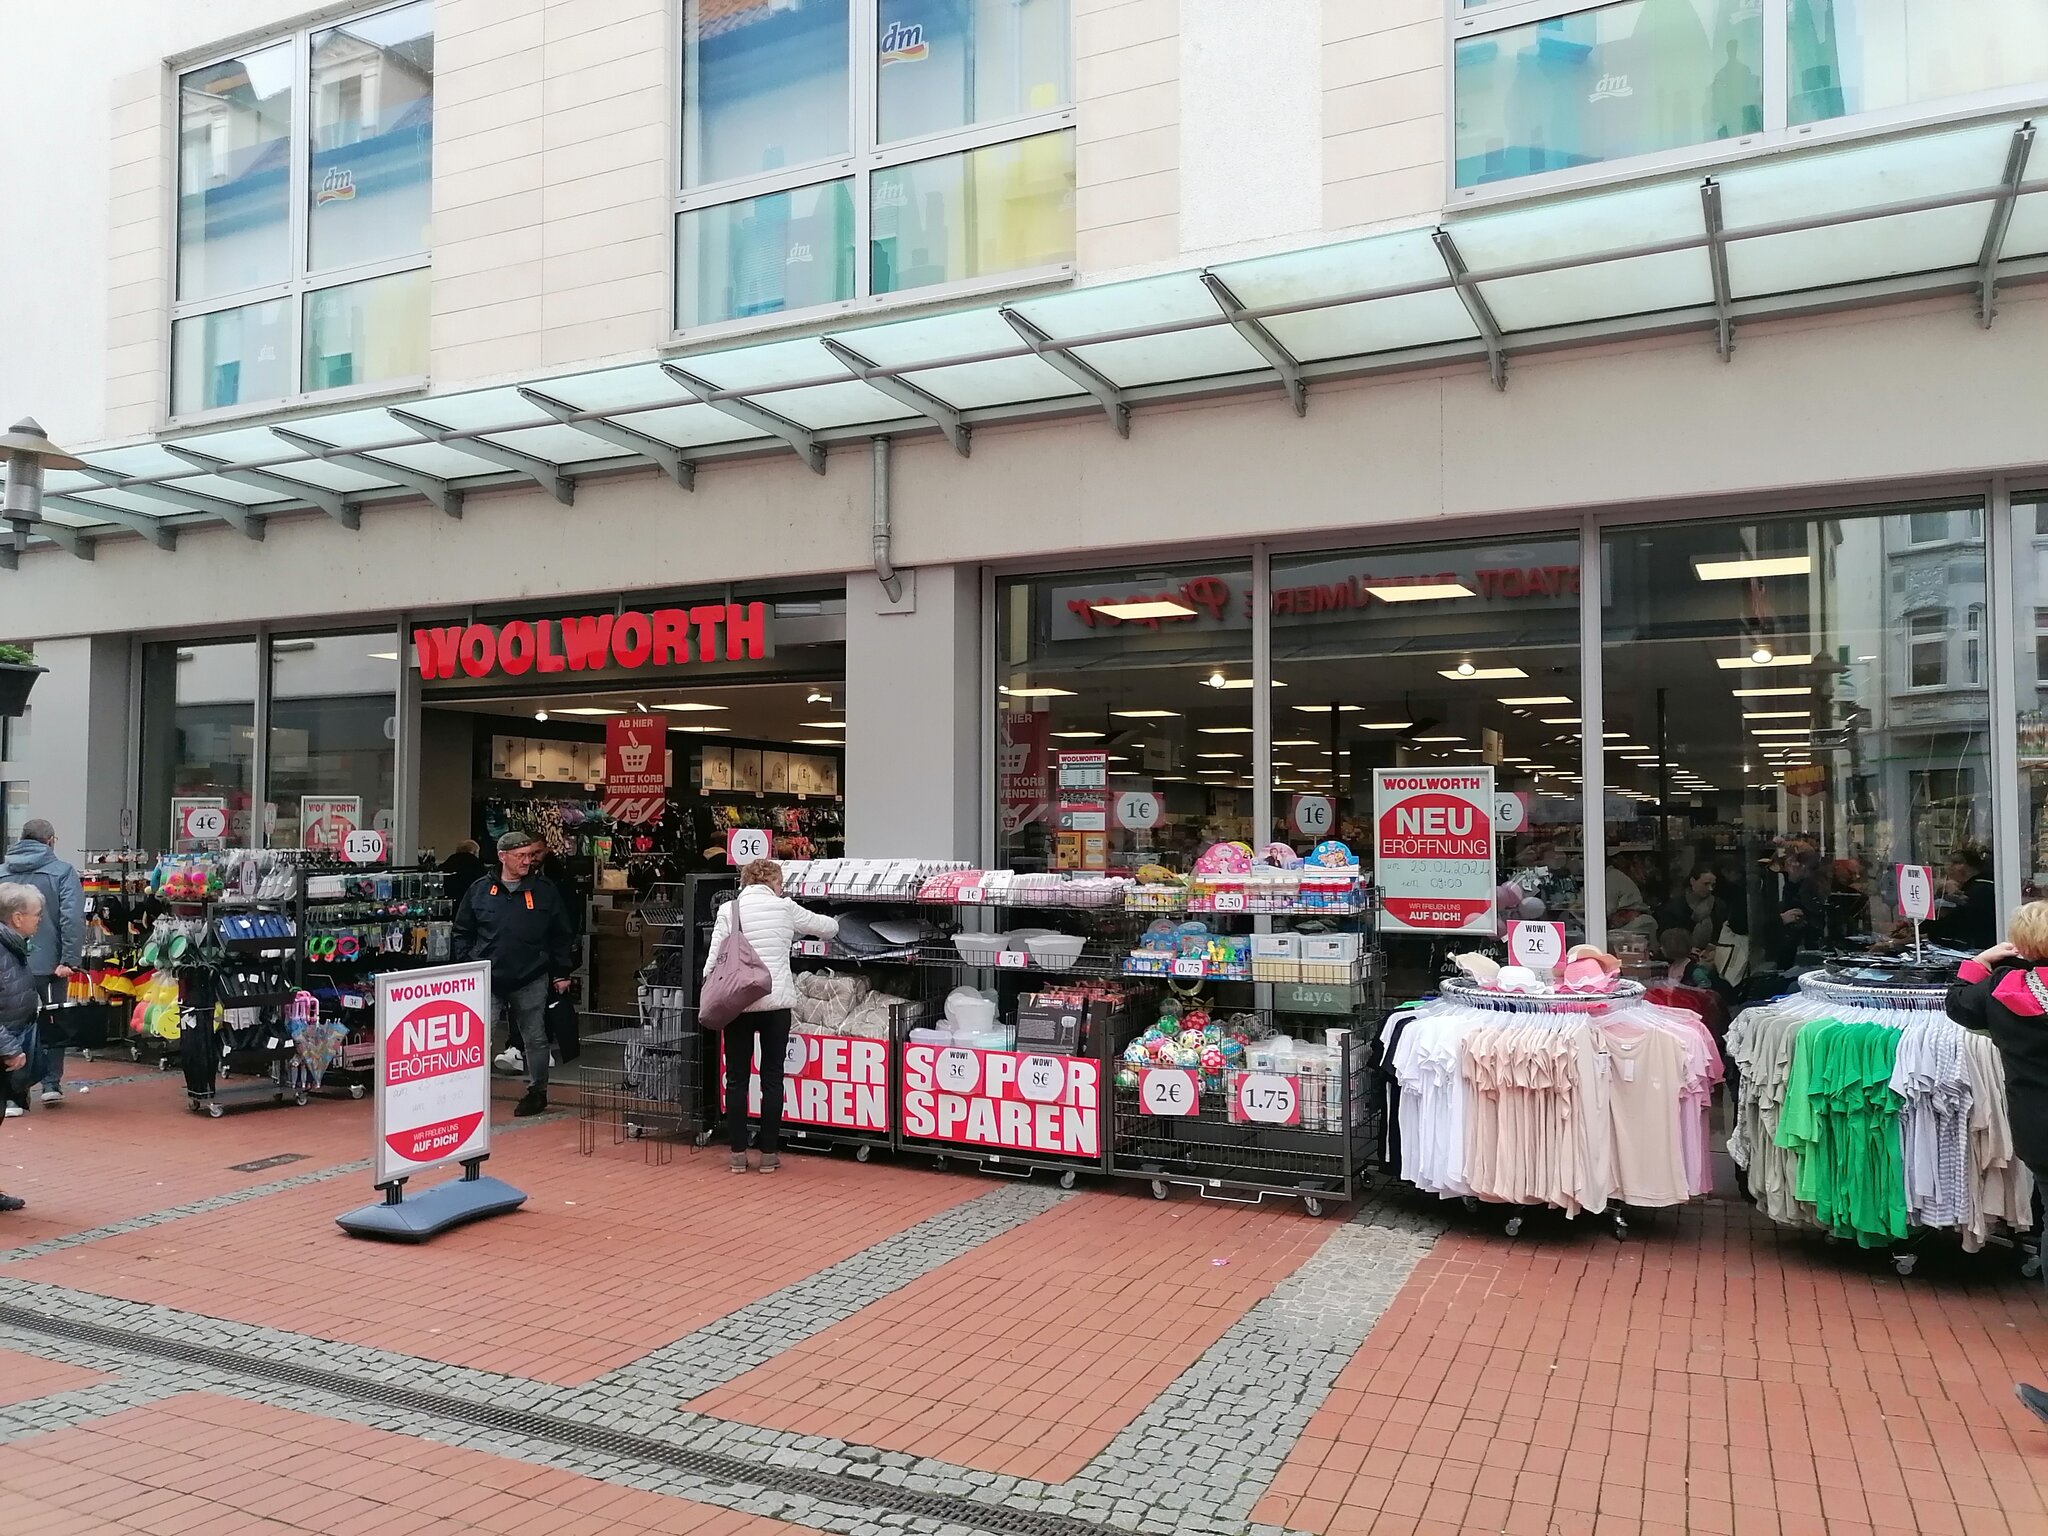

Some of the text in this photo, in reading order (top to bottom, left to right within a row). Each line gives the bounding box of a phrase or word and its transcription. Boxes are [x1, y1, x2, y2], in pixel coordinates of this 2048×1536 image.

[882, 22, 922, 53] dm
[1595, 73, 1628, 92] dm
[323, 168, 351, 192] dm
[414, 602, 766, 680] WOOLWORTH
[618, 719, 653, 728] AB HIER
[1007, 714, 1033, 724] HIER
[1061, 755, 1102, 763] WOOLWORTH
[610, 774, 663, 783] BITTE KORB
[1013, 777, 1046, 787] KORB
[1383, 778, 1480, 790] WOOLWORTH
[606, 785, 664, 794] VERWENDEN!
[1000, 789, 1047, 798] ENDEN!
[309, 804, 356, 812] WOORTH
[1126, 802, 1150, 819] 1€
[1304, 807, 1325, 825] 1€
[1396, 807, 1473, 836] NEU
[196, 817, 217, 830] 4€
[347, 839, 381, 853] 1.50
[739, 838, 761, 856] 3€
[1383, 836, 1488, 855] ERÖFFNUNG
[811, 885, 821, 894] 6€
[966, 889, 977, 899] 1€
[1218, 897, 1241, 909] 2.50
[1446, 903, 1461, 911] UNS
[1409, 912, 1461, 922] AUF DICH!
[1525, 924, 1546, 933] WOW!
[811, 944, 821, 953] 1€
[1528, 938, 1545, 952] 2€
[1008, 954, 1019, 964] 7€
[1178, 961, 1200, 974] 0.75
[390, 977, 475, 1002] WOOLWORTH
[1292, 986, 1333, 1007] days
[402, 1011, 470, 1055] NEU
[949, 1051, 968, 1059] WOW!
[389, 1045, 481, 1080] ERÖFFNUNG
[1032, 1057, 1053, 1067] WOW!
[906, 1046, 1096, 1106] SPR
[950, 1064, 965, 1077] 3€
[1032, 1071, 1049, 1086] 8€
[1155, 1083, 1181, 1103] 2€
[1245, 1088, 1289, 1110] 1.75
[905, 1091, 1096, 1156] SPAREN
[413, 1123, 459, 1141] WIR FREUEN UNS
[412, 1132, 459, 1154] AUF DICH!
